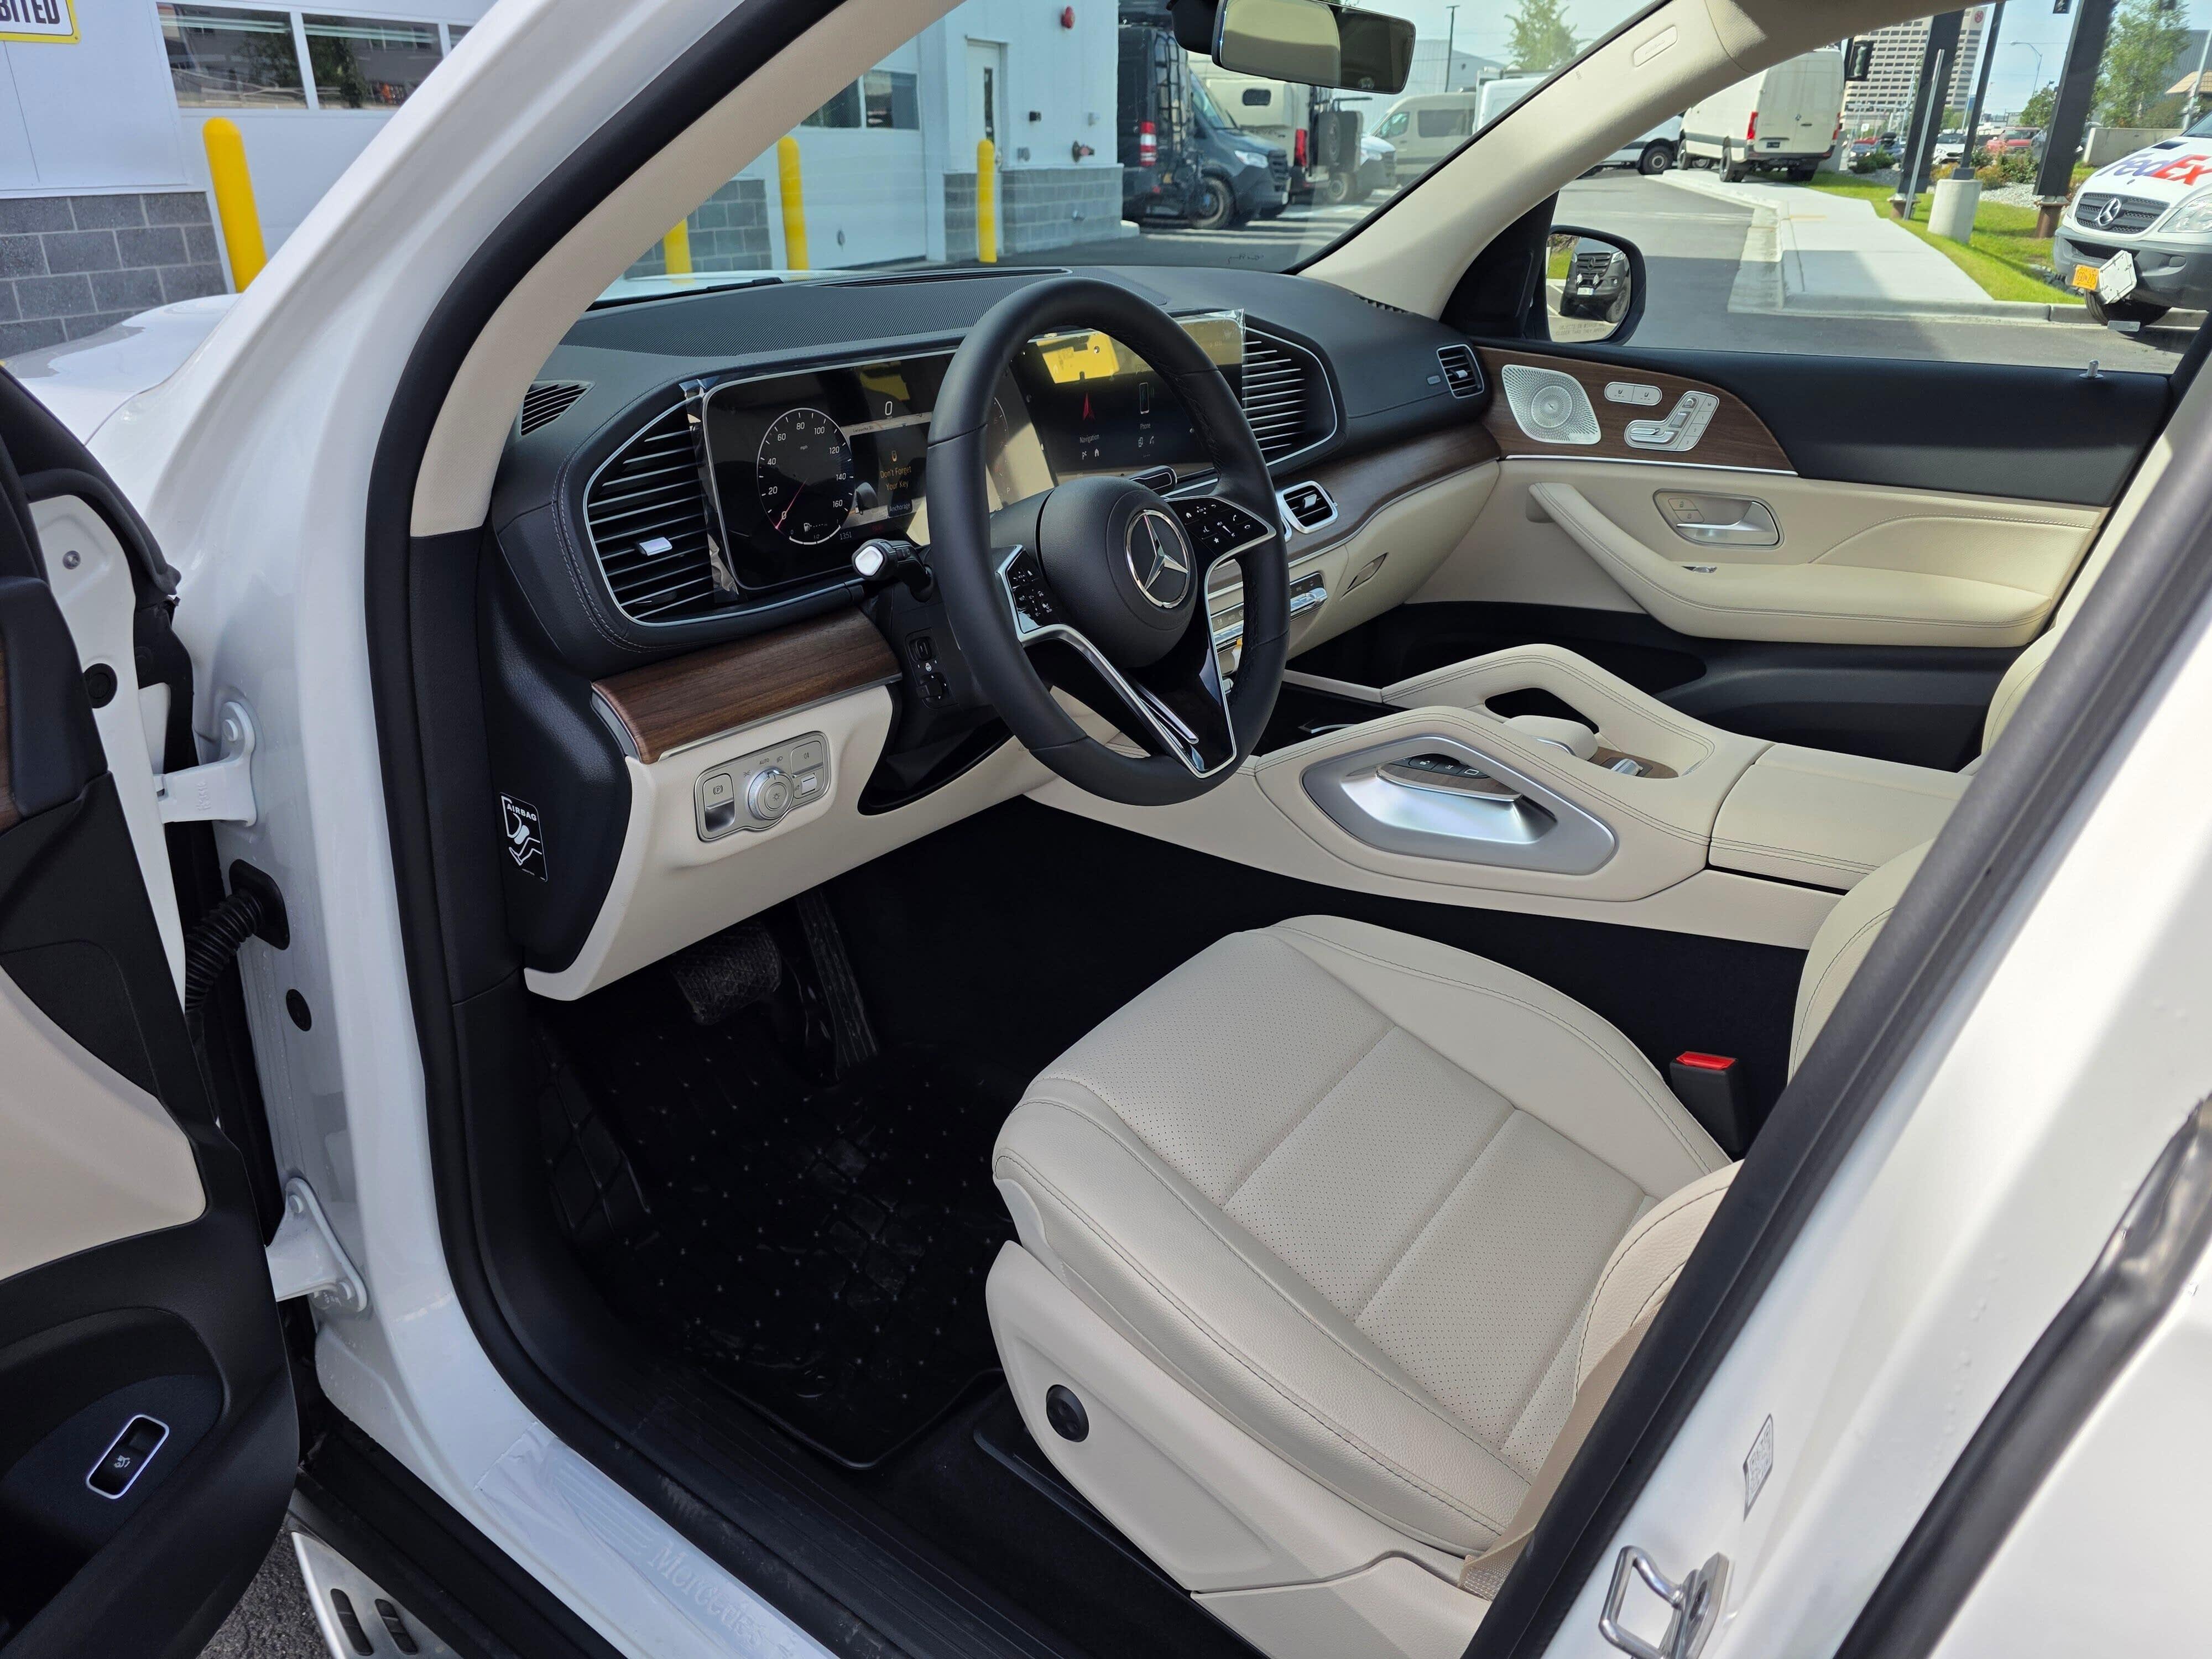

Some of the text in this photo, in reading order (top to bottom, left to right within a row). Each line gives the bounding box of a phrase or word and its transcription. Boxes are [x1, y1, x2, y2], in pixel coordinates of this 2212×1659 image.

[796, 422, 805, 430] 80
[814, 426, 825, 435] 100
[778, 433, 786, 441] 60
[1079, 434, 1099, 444] Navigation
[767, 457, 776, 466] 40
[880, 466, 911, 478] Don't Forget
[836, 473, 846, 481] 140
[768, 486, 778, 495] 20
[886, 481, 909, 491] Your Key
[833, 499, 843, 508] 160
[890, 503, 911, 512] Anchorage
[507, 804, 537, 821] AIRBAG
